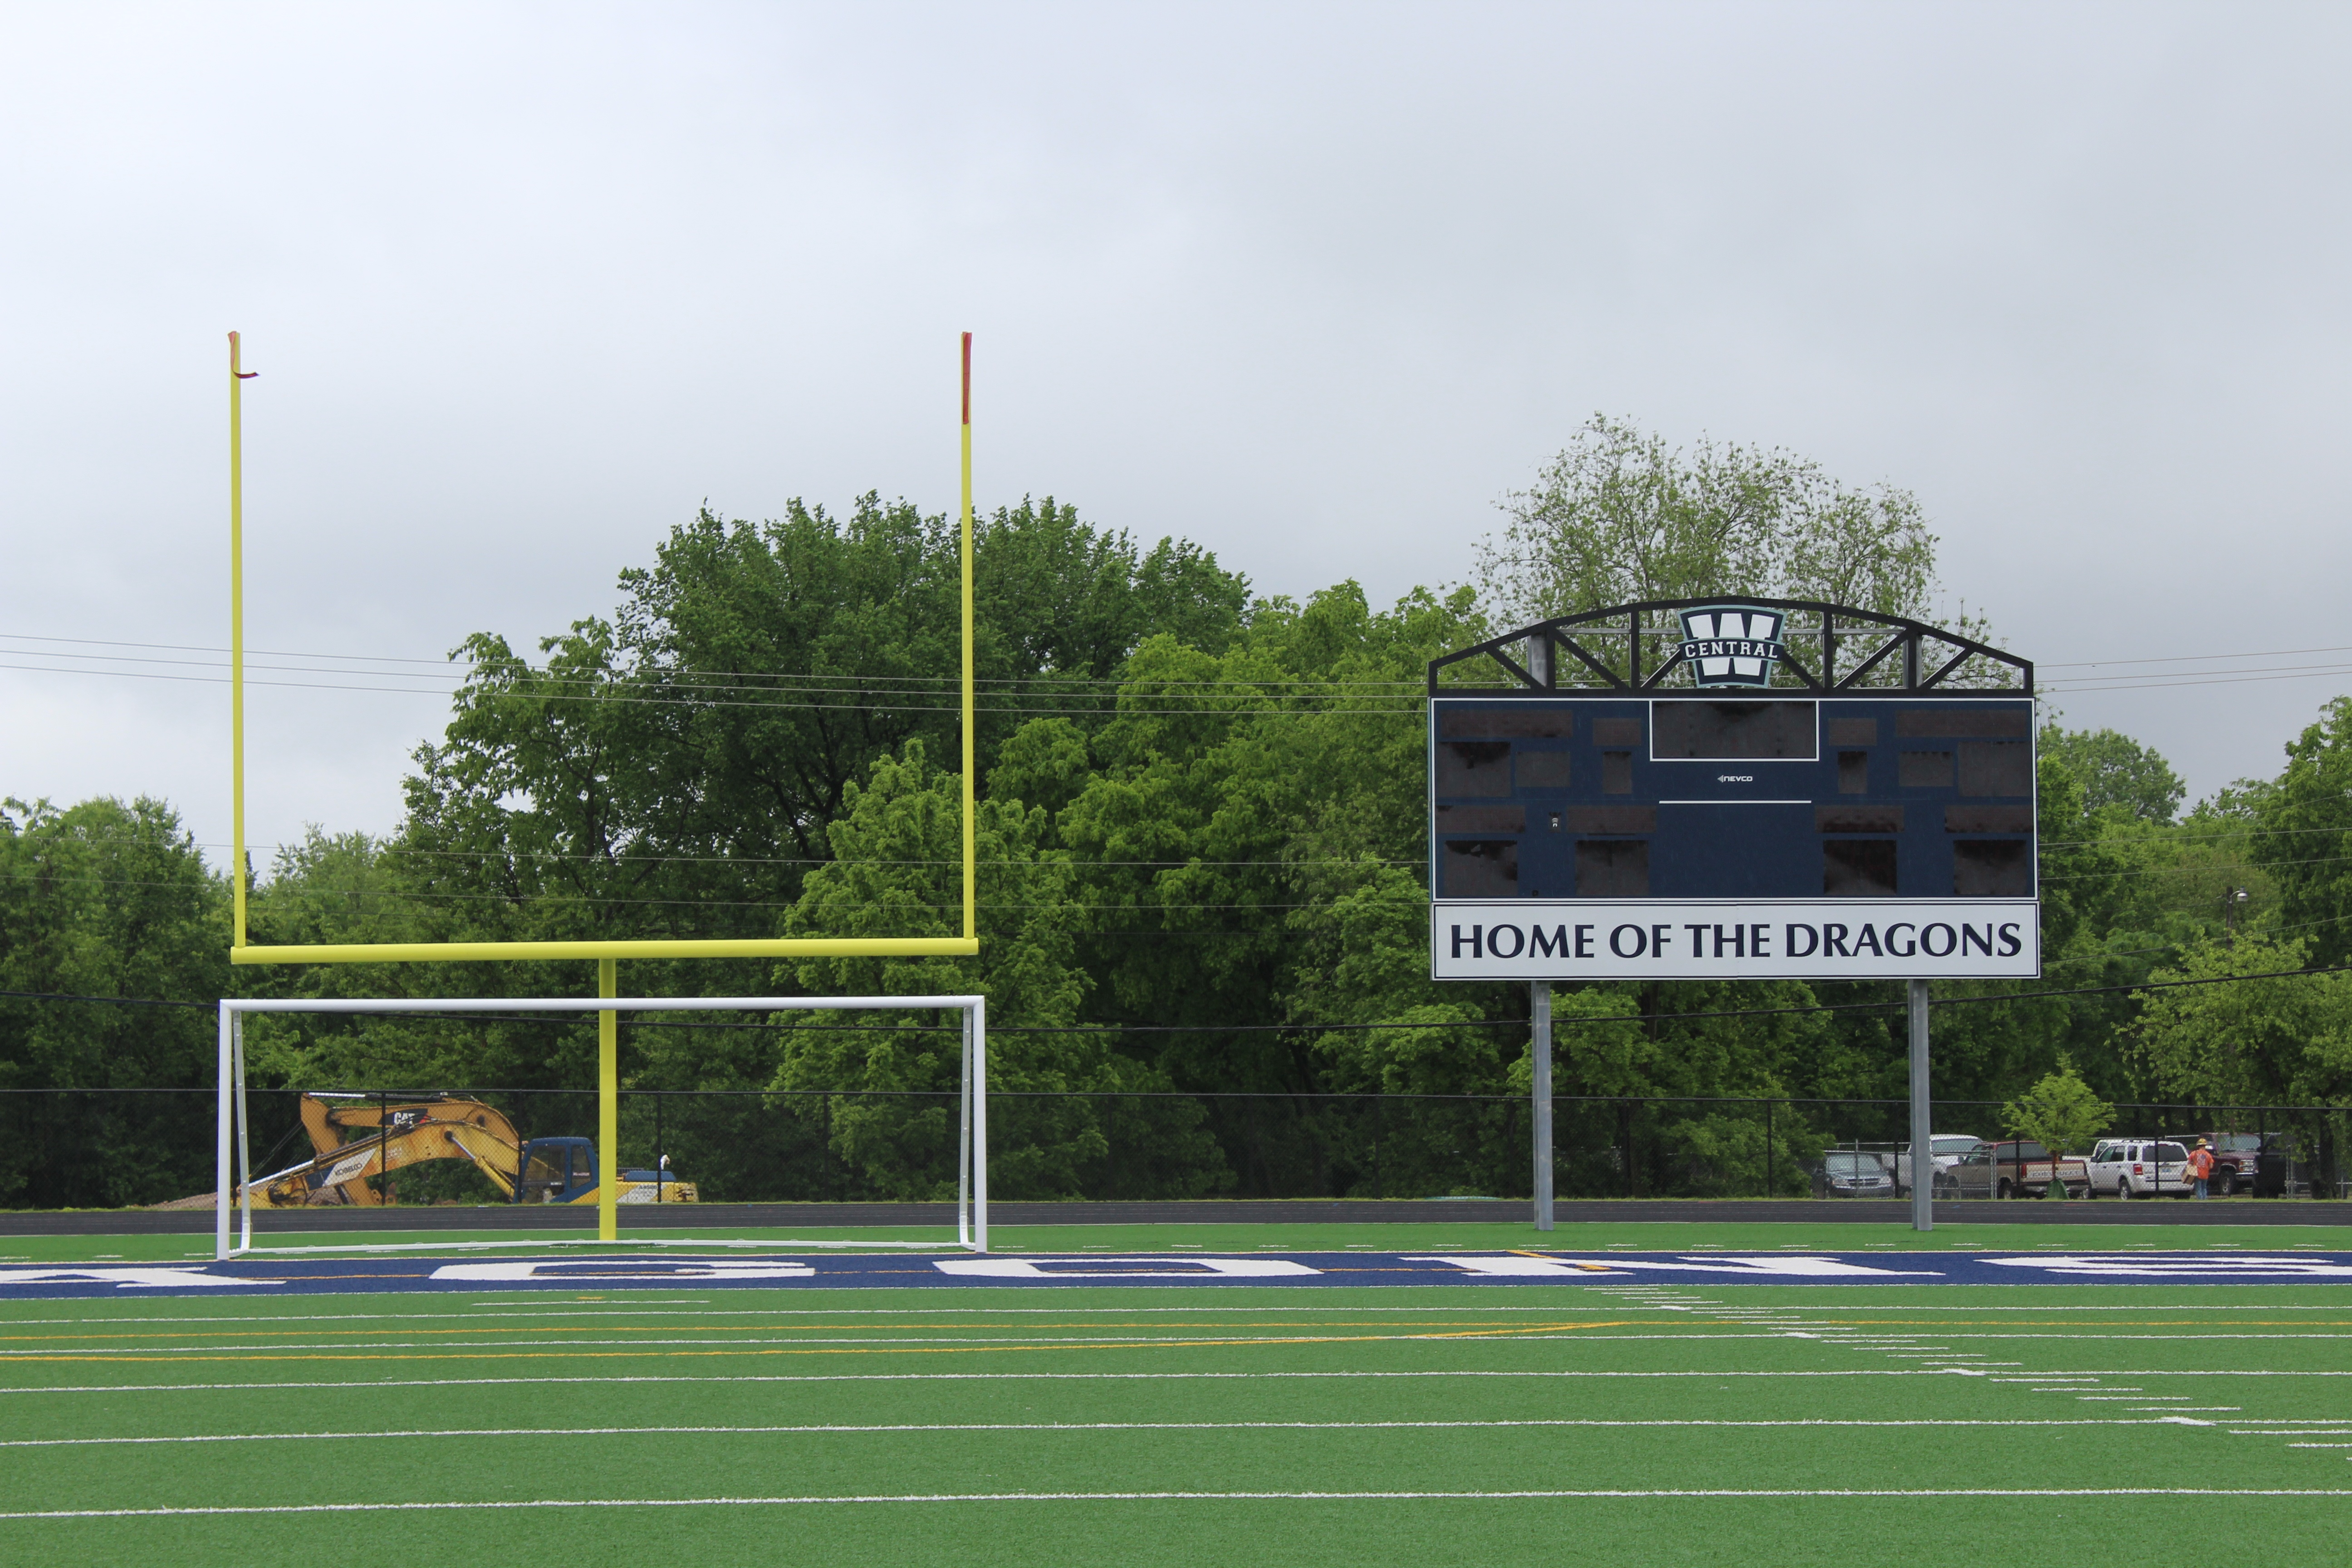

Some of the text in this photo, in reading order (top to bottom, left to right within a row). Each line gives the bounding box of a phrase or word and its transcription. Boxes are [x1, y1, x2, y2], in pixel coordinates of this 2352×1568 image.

[1685, 641, 1778, 658] CENTRAL
[1451, 923, 2022, 958] HOME OF THE DRAGONS
[394, 1112, 415, 1124] CAT
